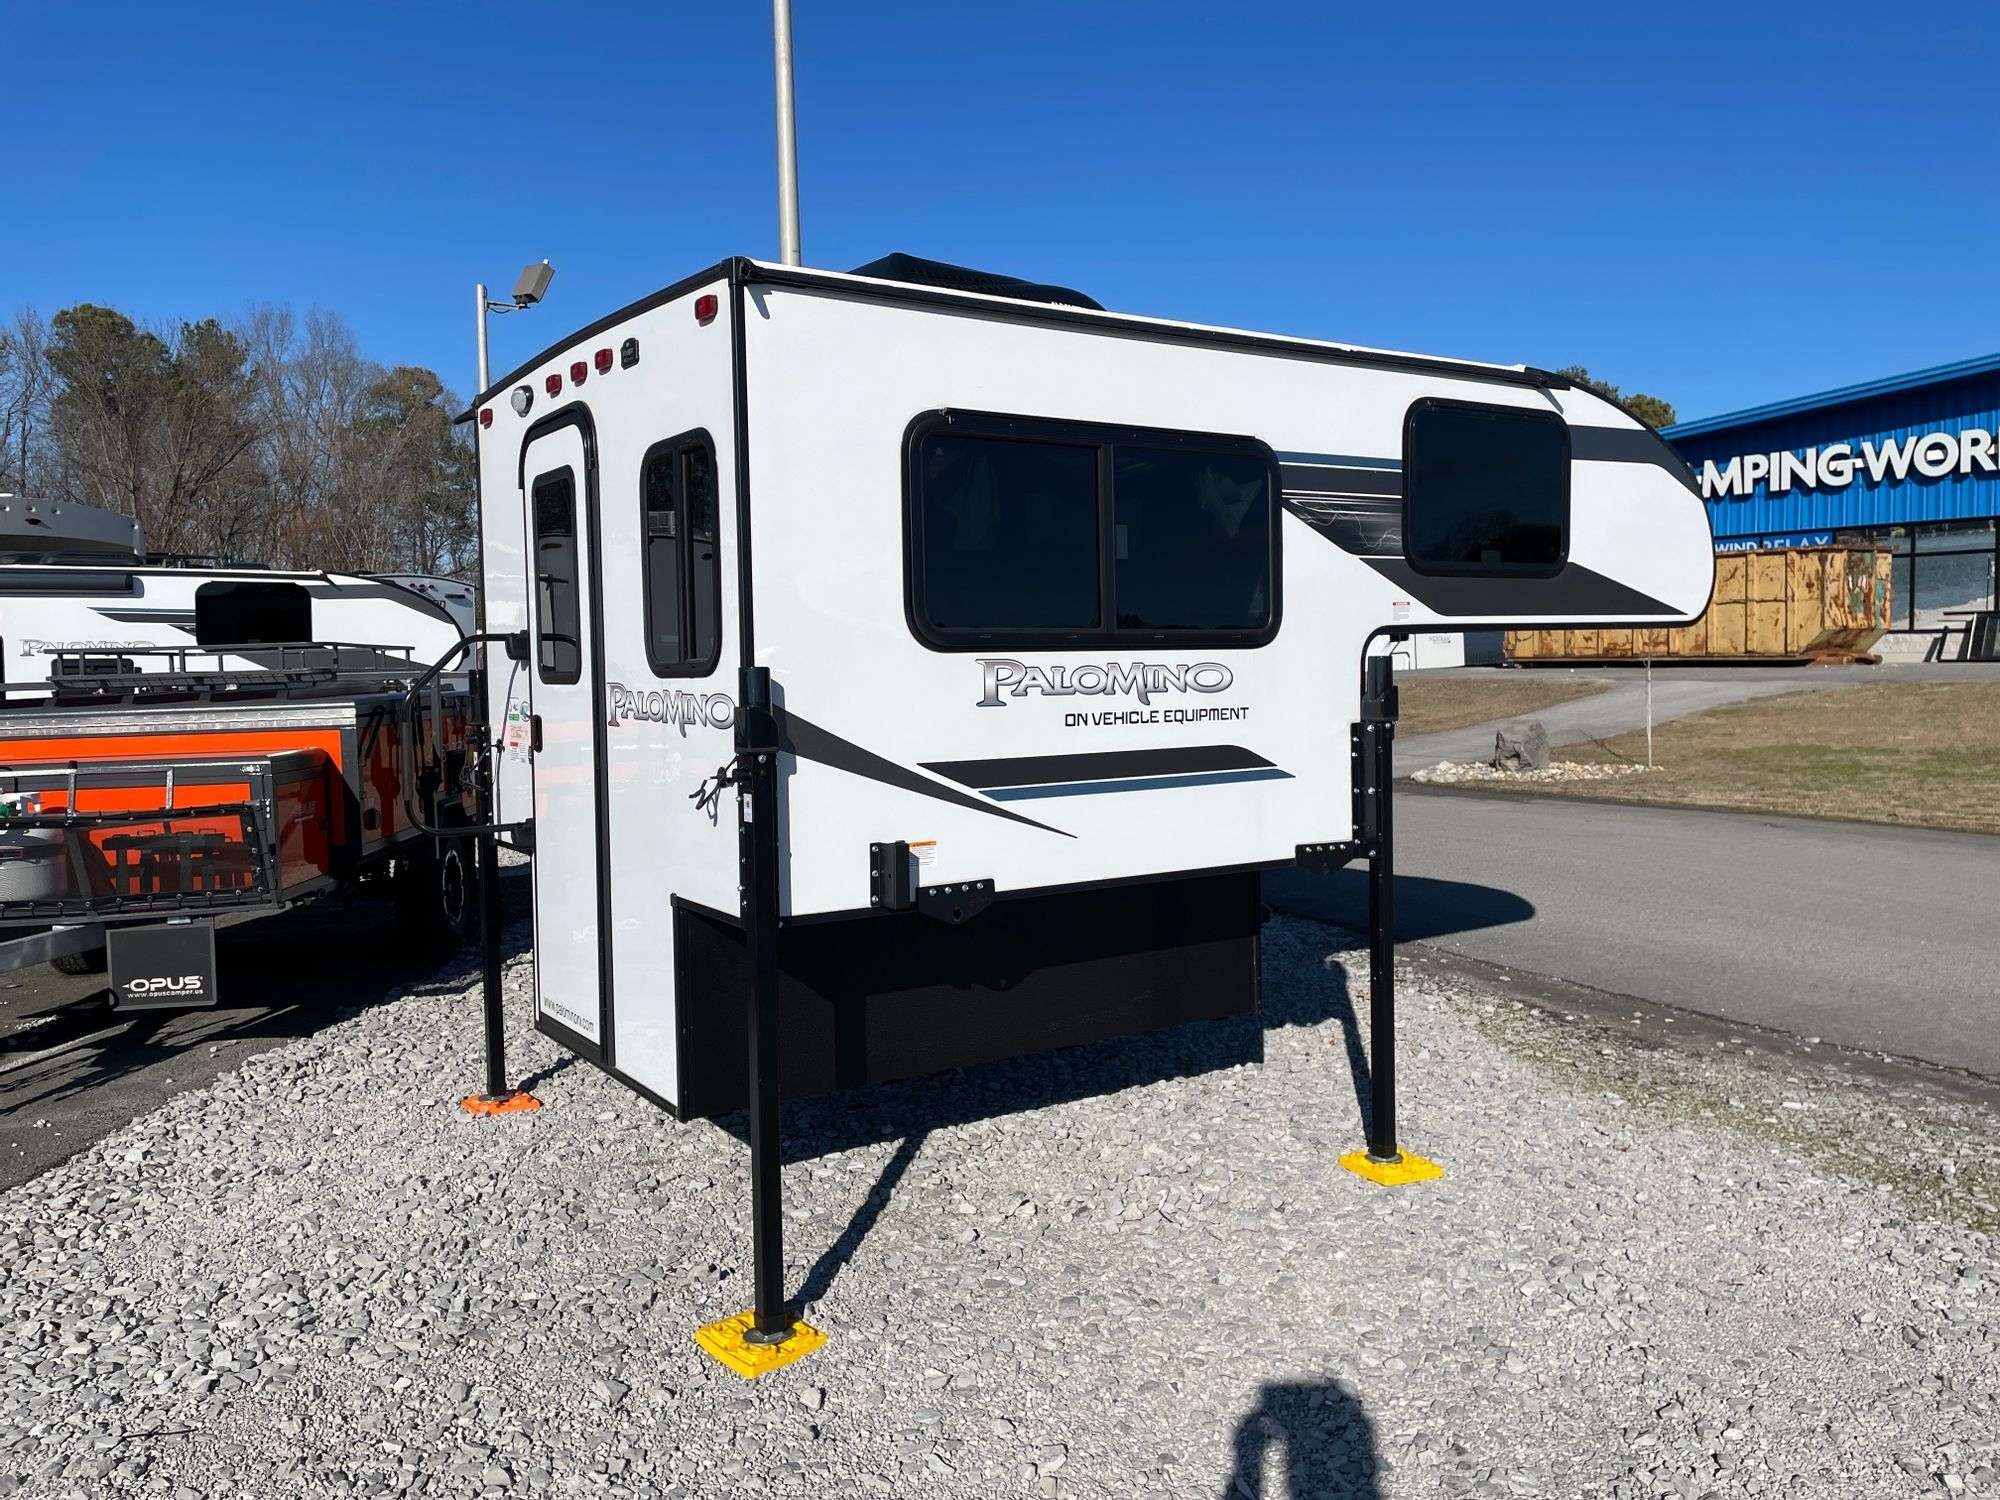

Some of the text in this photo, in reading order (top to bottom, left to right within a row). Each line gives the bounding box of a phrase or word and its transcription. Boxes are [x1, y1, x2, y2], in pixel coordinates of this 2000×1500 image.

[1697, 427, 2000, 498] MPING WOR
[975, 658, 1233, 707] PALOMINO
[1065, 707, 1249, 727] ON VEHICLE EQUIPMENT
[129, 975, 201, 991] OPUS
